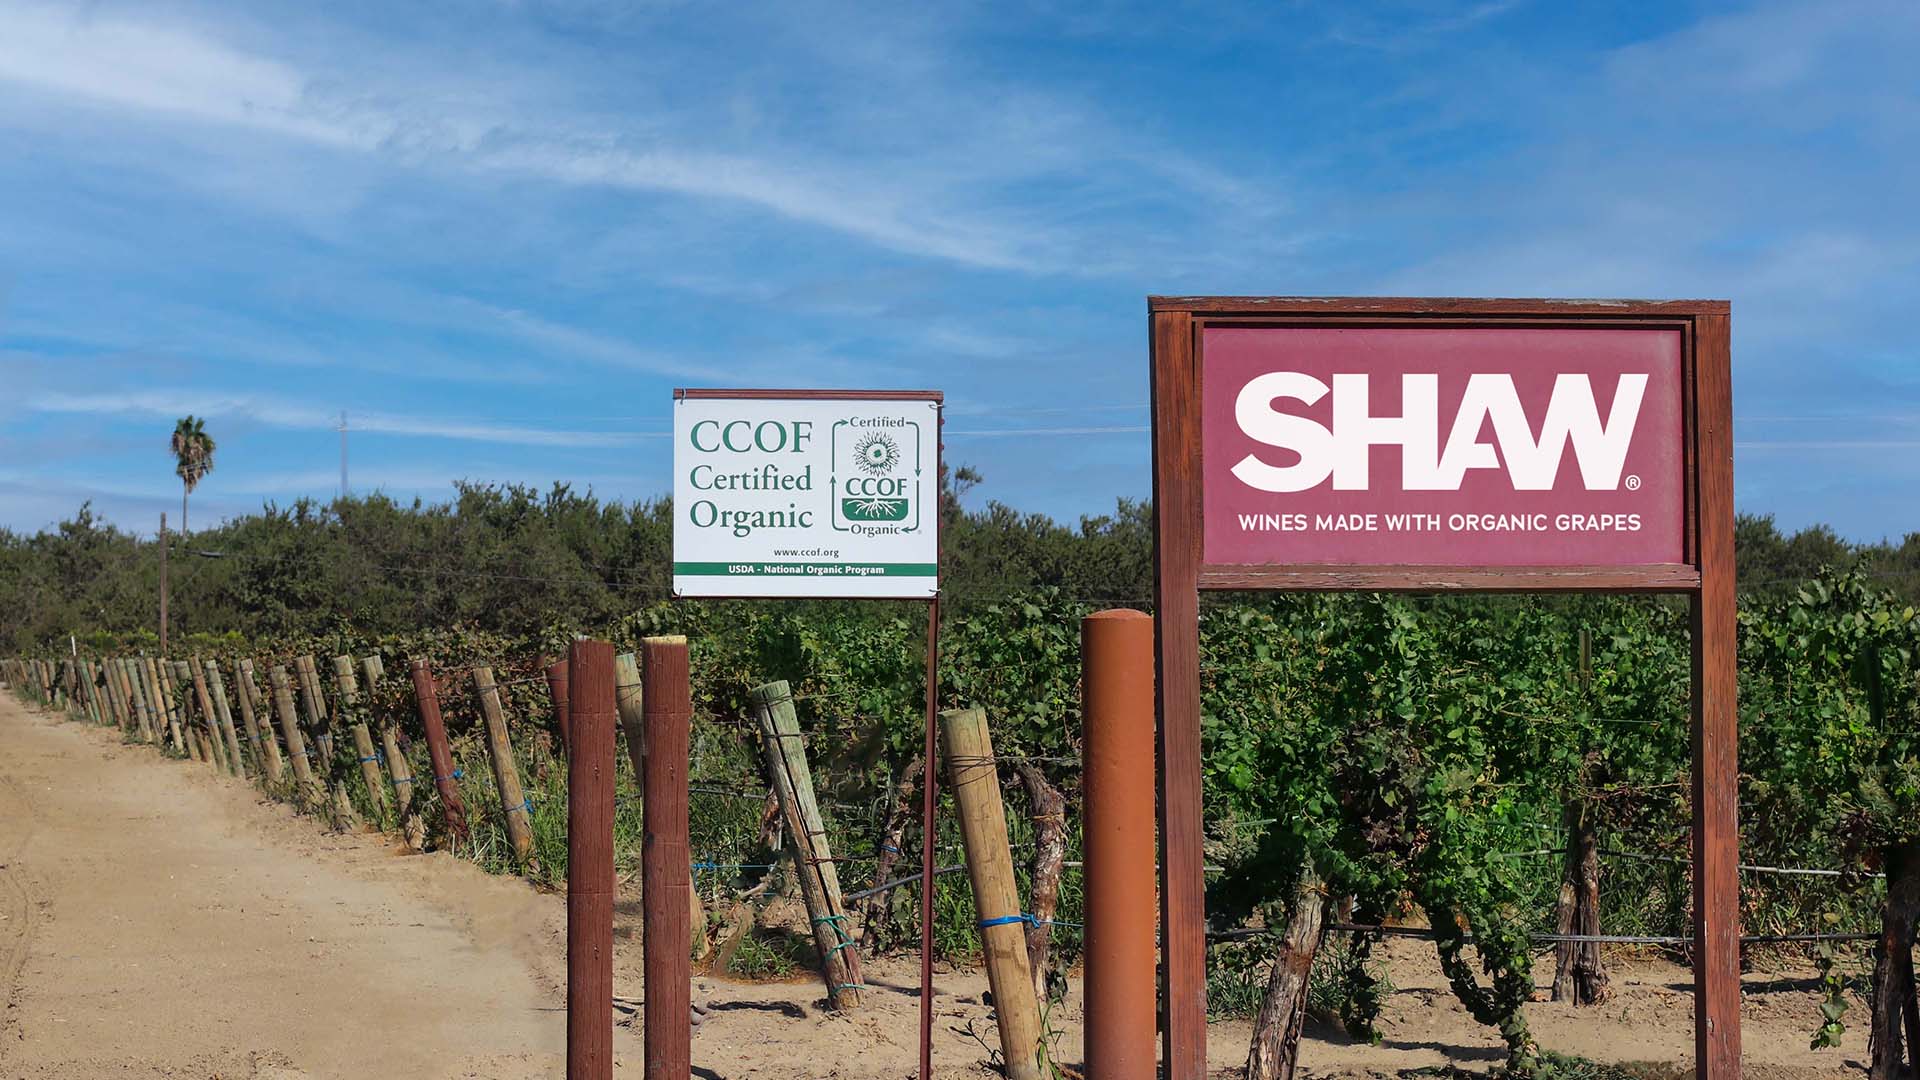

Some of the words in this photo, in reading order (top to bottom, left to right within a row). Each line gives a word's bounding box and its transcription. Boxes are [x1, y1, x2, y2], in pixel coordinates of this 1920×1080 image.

[850, 416, 905, 428] Certified
[691, 420, 812, 453] CCOF
[690, 464, 812, 490] Certified
[846, 478, 907, 496] CCOF
[690, 500, 813, 537] Organic
[1238, 514, 1307, 530] WINES
[1316, 514, 1377, 530] MADE
[1385, 514, 1440, 530] WITH
[1449, 514, 1547, 531] ORGANIC
[1556, 514, 1641, 530] GRAPES
[851, 524, 900, 537] Organic
[774, 548, 839, 558] www.ccof.org
[729, 565, 754, 573] USDA
[764, 565, 803, 573] National
[807, 565, 842, 574] Organic
[846, 566, 884, 574] Program
